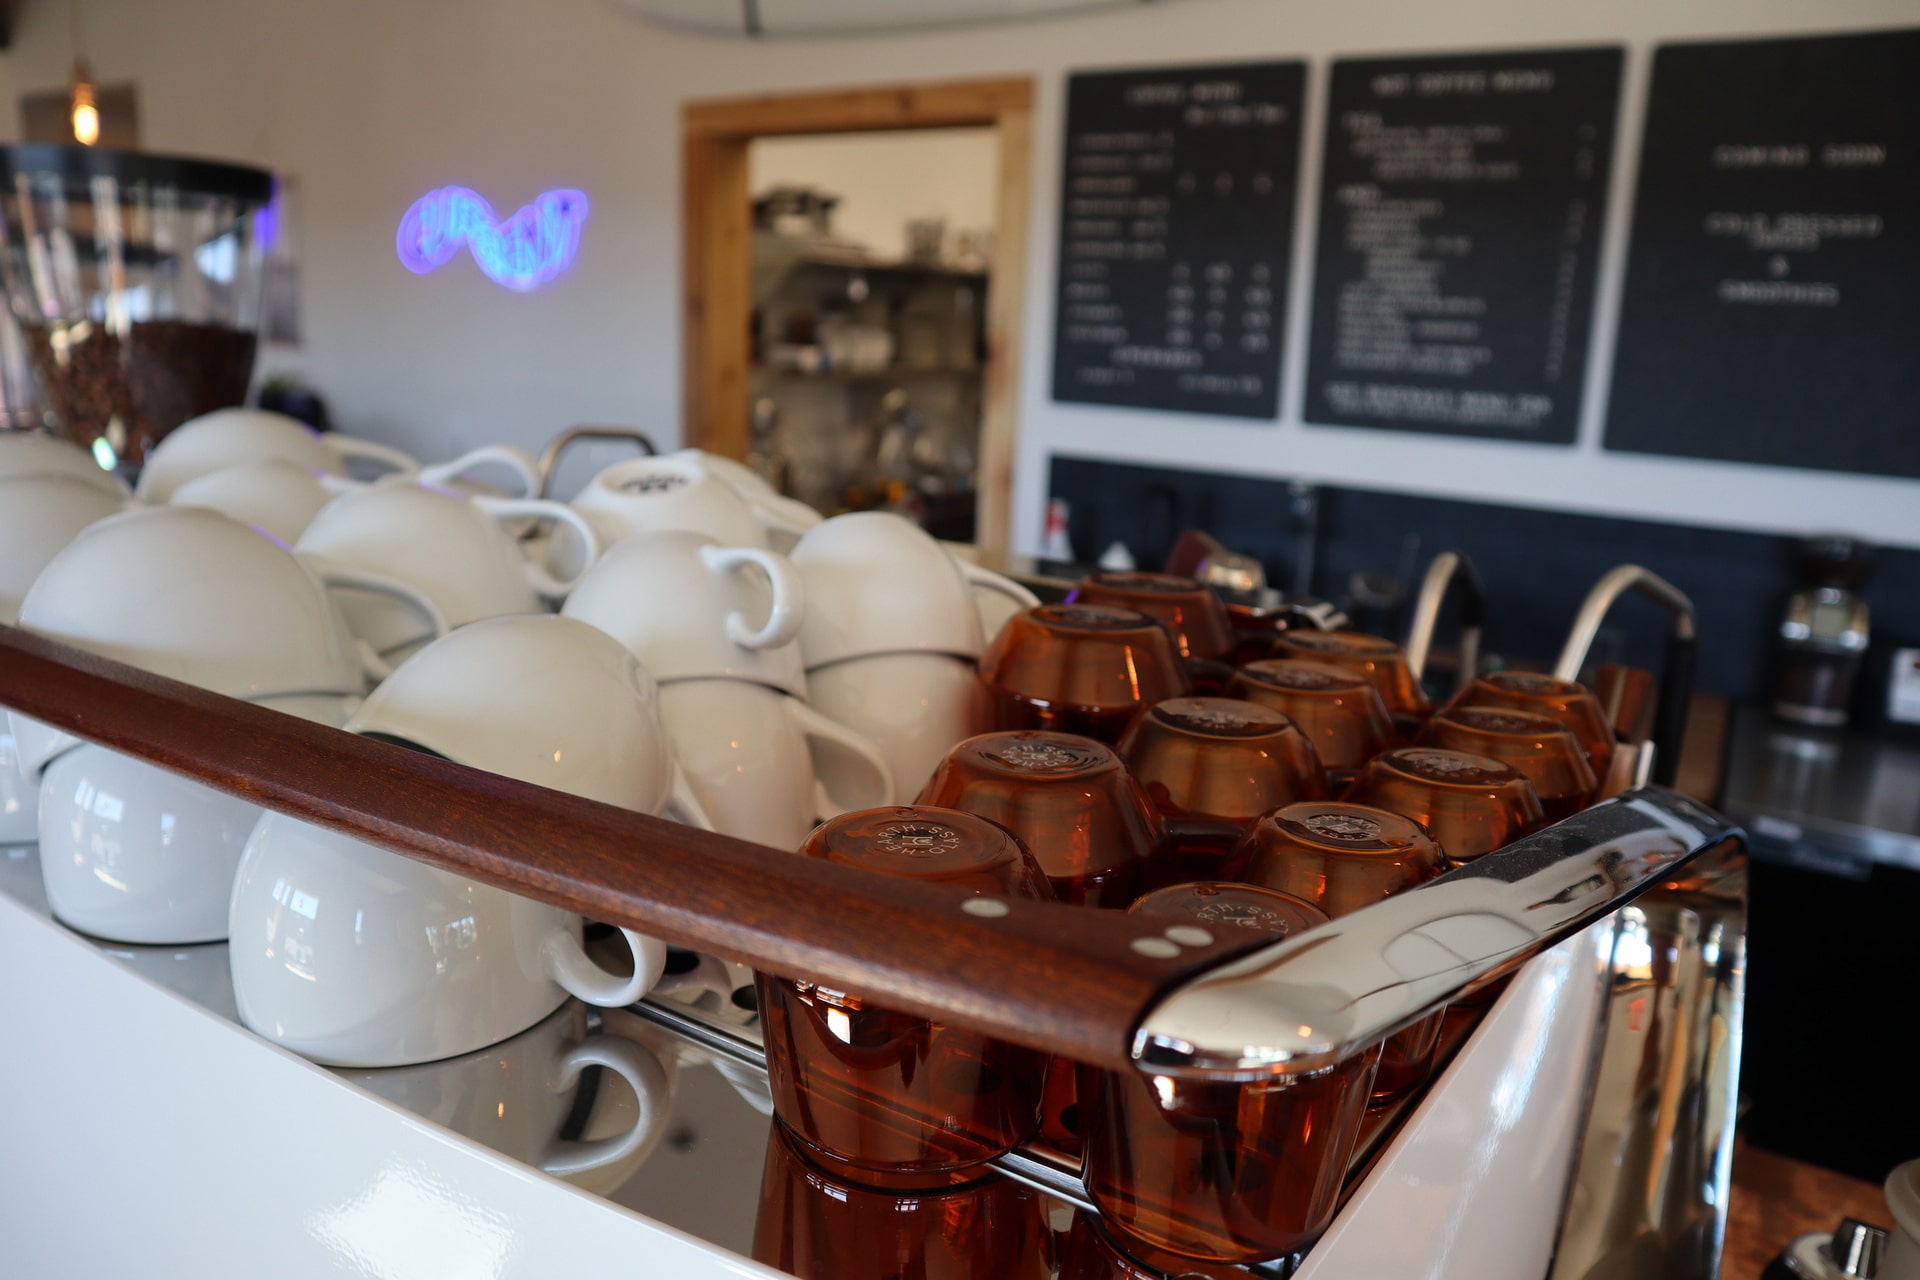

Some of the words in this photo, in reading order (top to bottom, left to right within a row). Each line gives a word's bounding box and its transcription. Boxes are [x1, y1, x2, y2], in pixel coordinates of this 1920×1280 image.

[1714, 146, 1809, 166] COMING
[1822, 145, 1886, 166] SOON
[1719, 281, 1840, 305] SMOOTHIES
[877, 824, 917, 855] HEARTH
